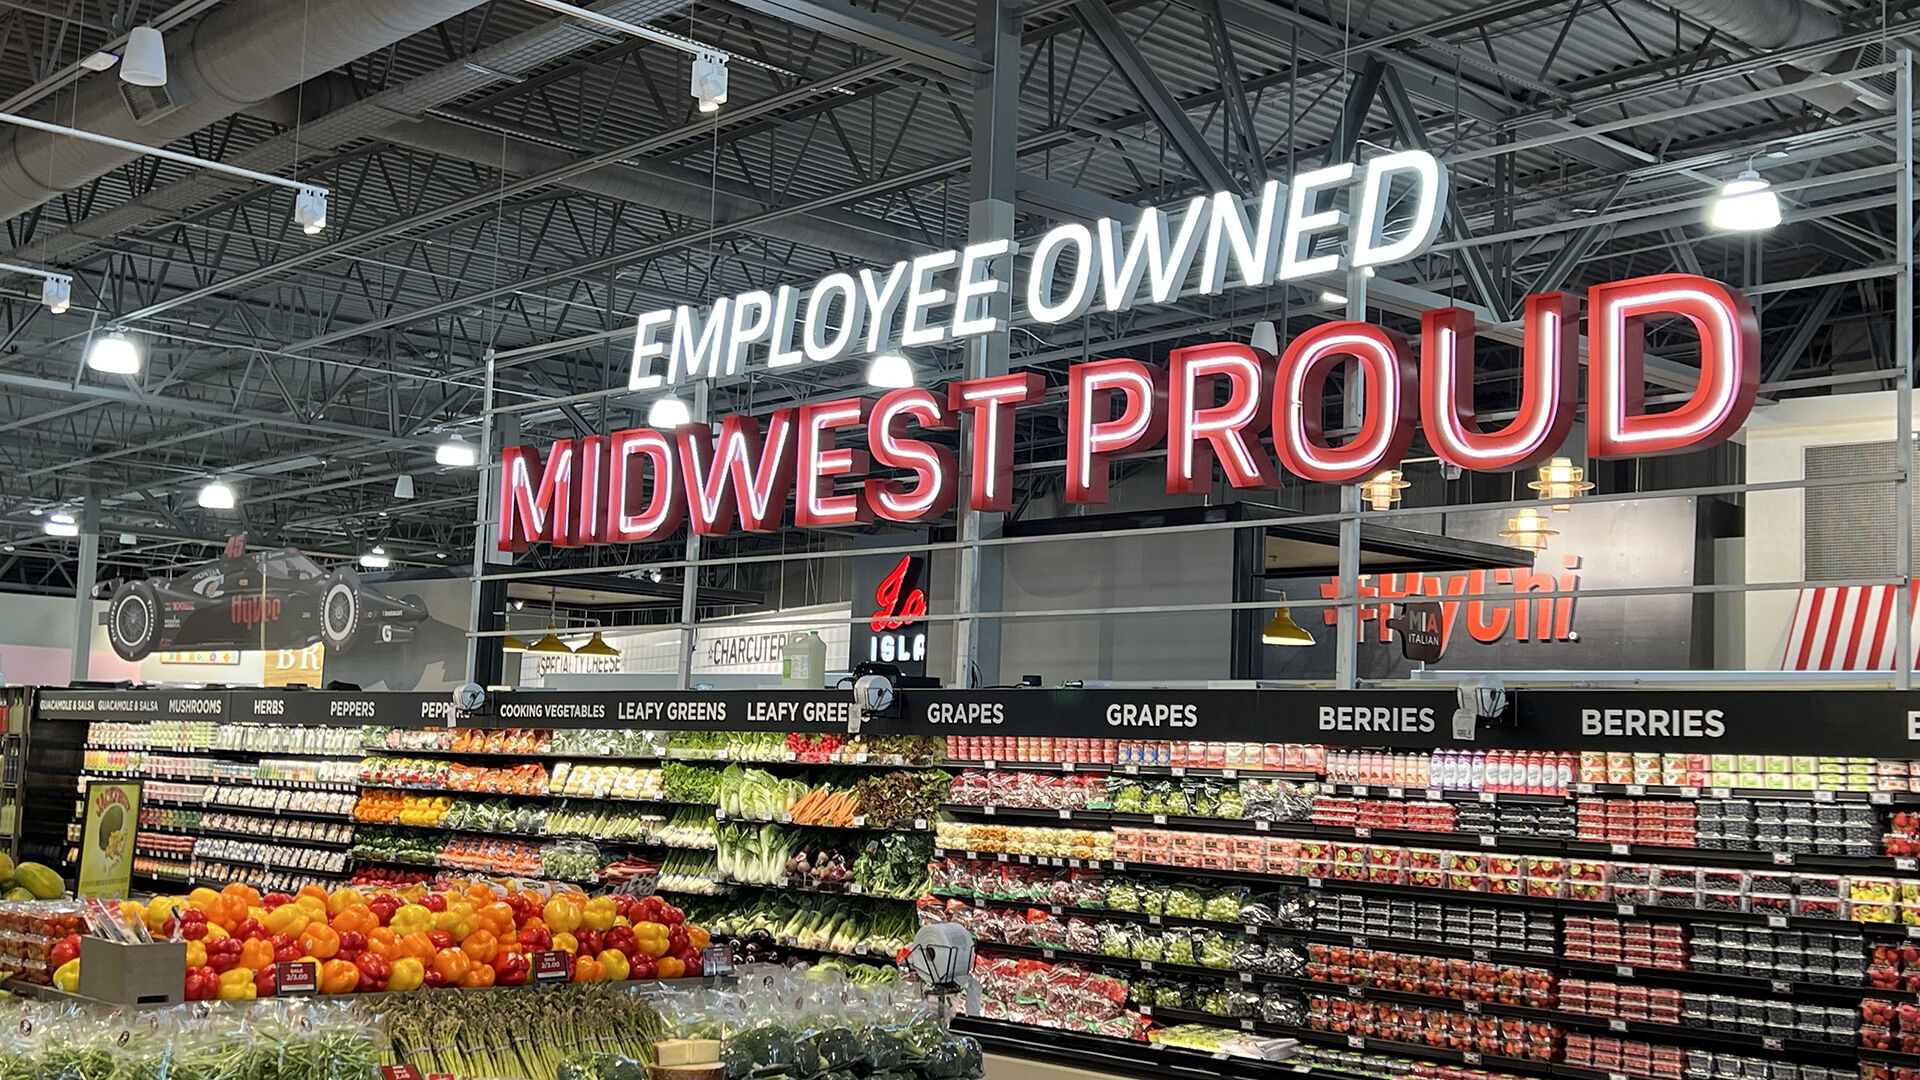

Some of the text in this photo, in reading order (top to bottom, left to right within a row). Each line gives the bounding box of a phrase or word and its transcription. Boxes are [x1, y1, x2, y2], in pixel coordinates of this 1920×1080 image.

[628, 149, 1446, 391] EMPLOYEE OWNED
[498, 273, 1760, 553] MIDWEST PROUD
[224, 536, 244, 557] 45
[1409, 610, 1439, 633] MIA
[870, 634, 926, 662] ISLA
[1408, 632, 1440, 646] ITALIAN
[39, 699, 72, 711] GUACAMOLE
[77, 700, 95, 711] SALSA
[98, 699, 158, 712] GUACAMOLE & SALSA
[168, 699, 222, 714] MUSHROOMS
[254, 699, 284, 715] HERBS
[330, 701, 375, 718] PEPPERS
[421, 701, 472, 719] PEPP
[500, 704, 605, 718] COOKING VEGETABLES
[618, 702, 727, 721] LEAFY GREENS
[747, 702, 871, 723] LEAFY GREE
[927, 703, 1004, 725] GRAPES
[1106, 703, 1198, 728] GRAPES
[1319, 706, 1436, 733] BERRIES
[1581, 709, 1725, 738] BERRIES
